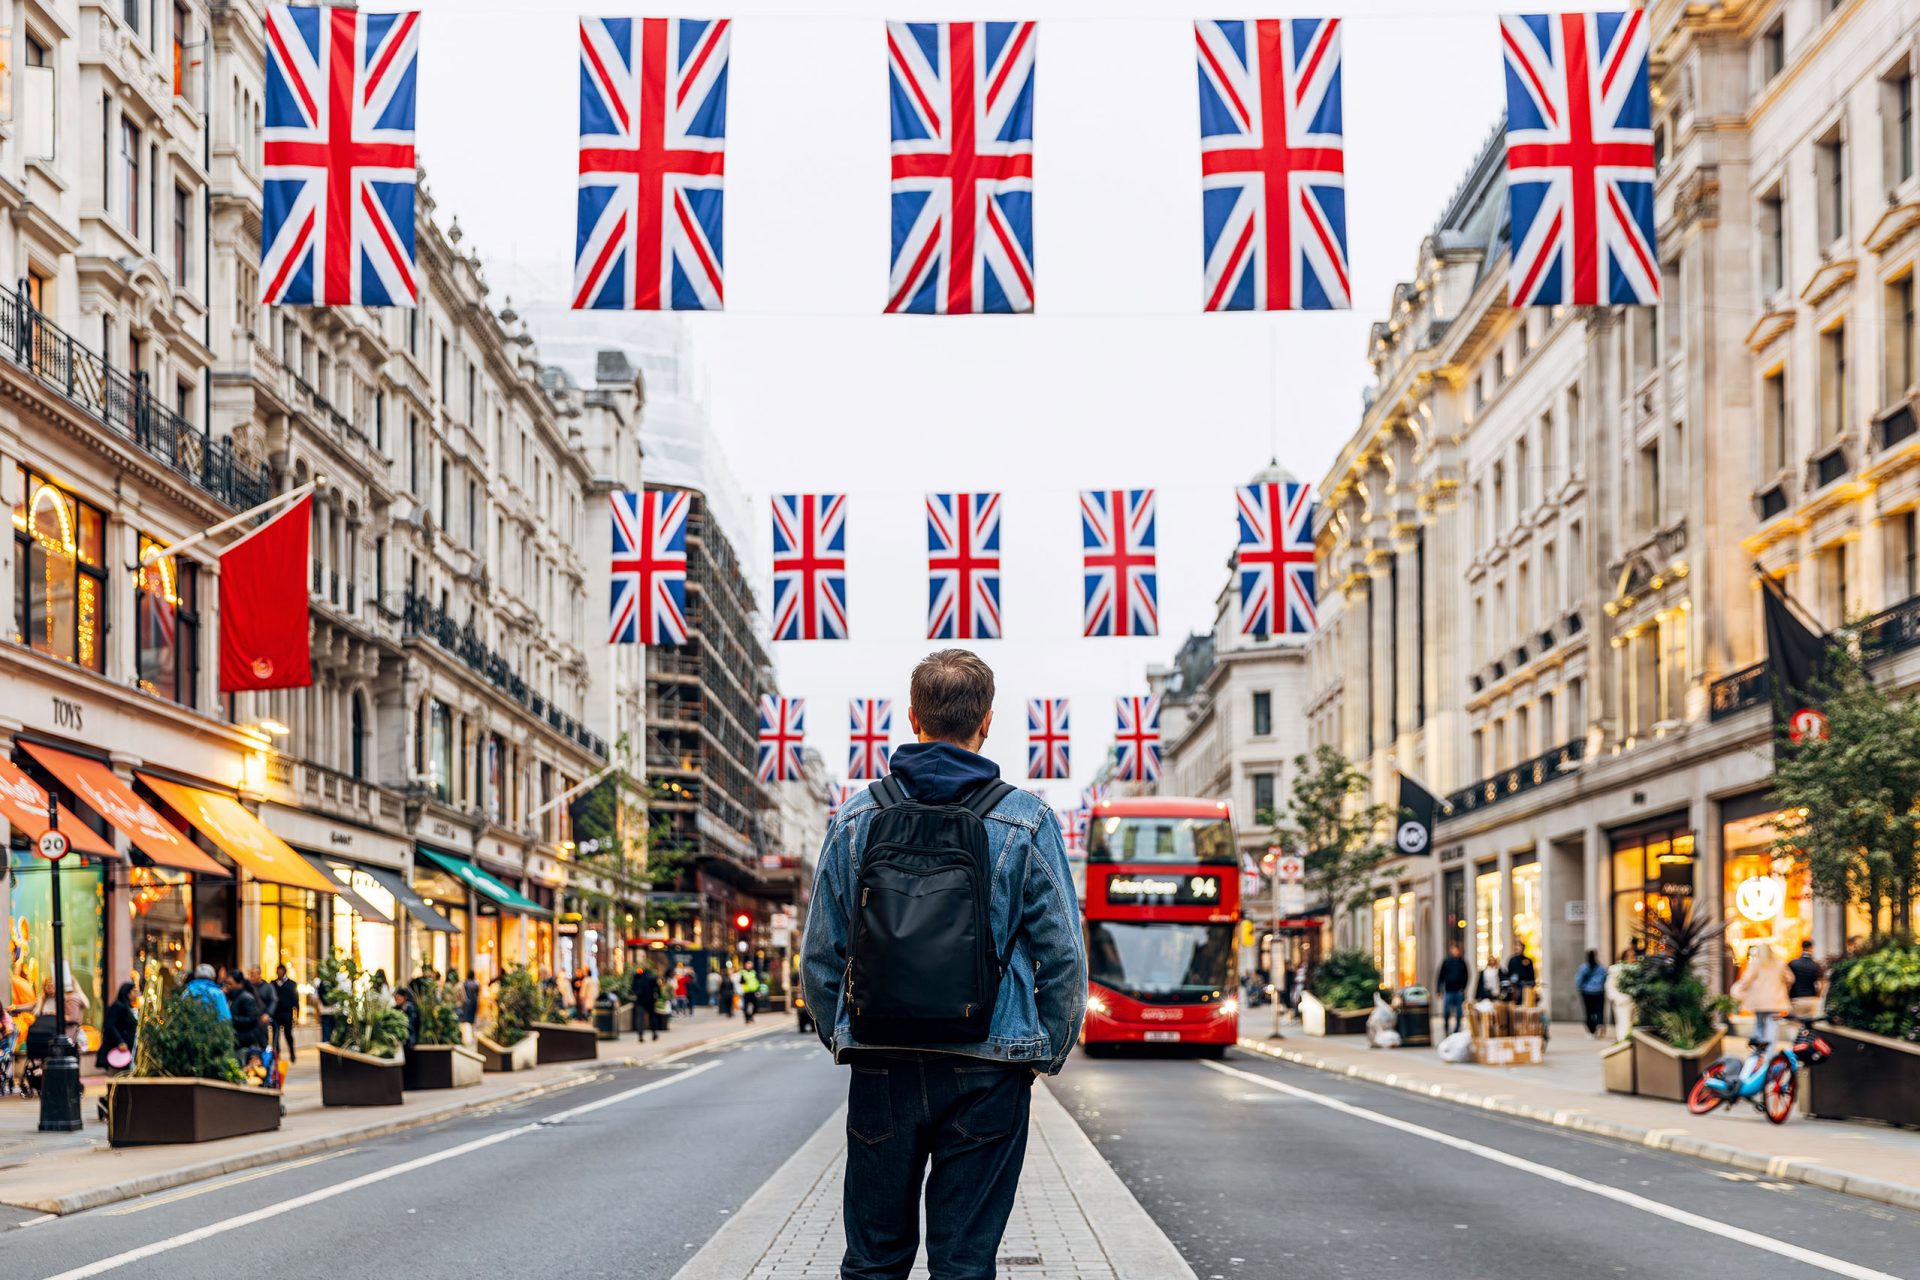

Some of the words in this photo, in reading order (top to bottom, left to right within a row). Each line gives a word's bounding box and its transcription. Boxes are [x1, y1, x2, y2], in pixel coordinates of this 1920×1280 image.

[52, 697, 83, 731] TOYS
[42, 838, 64, 851] 20
[1190, 876, 1217, 898] 94
